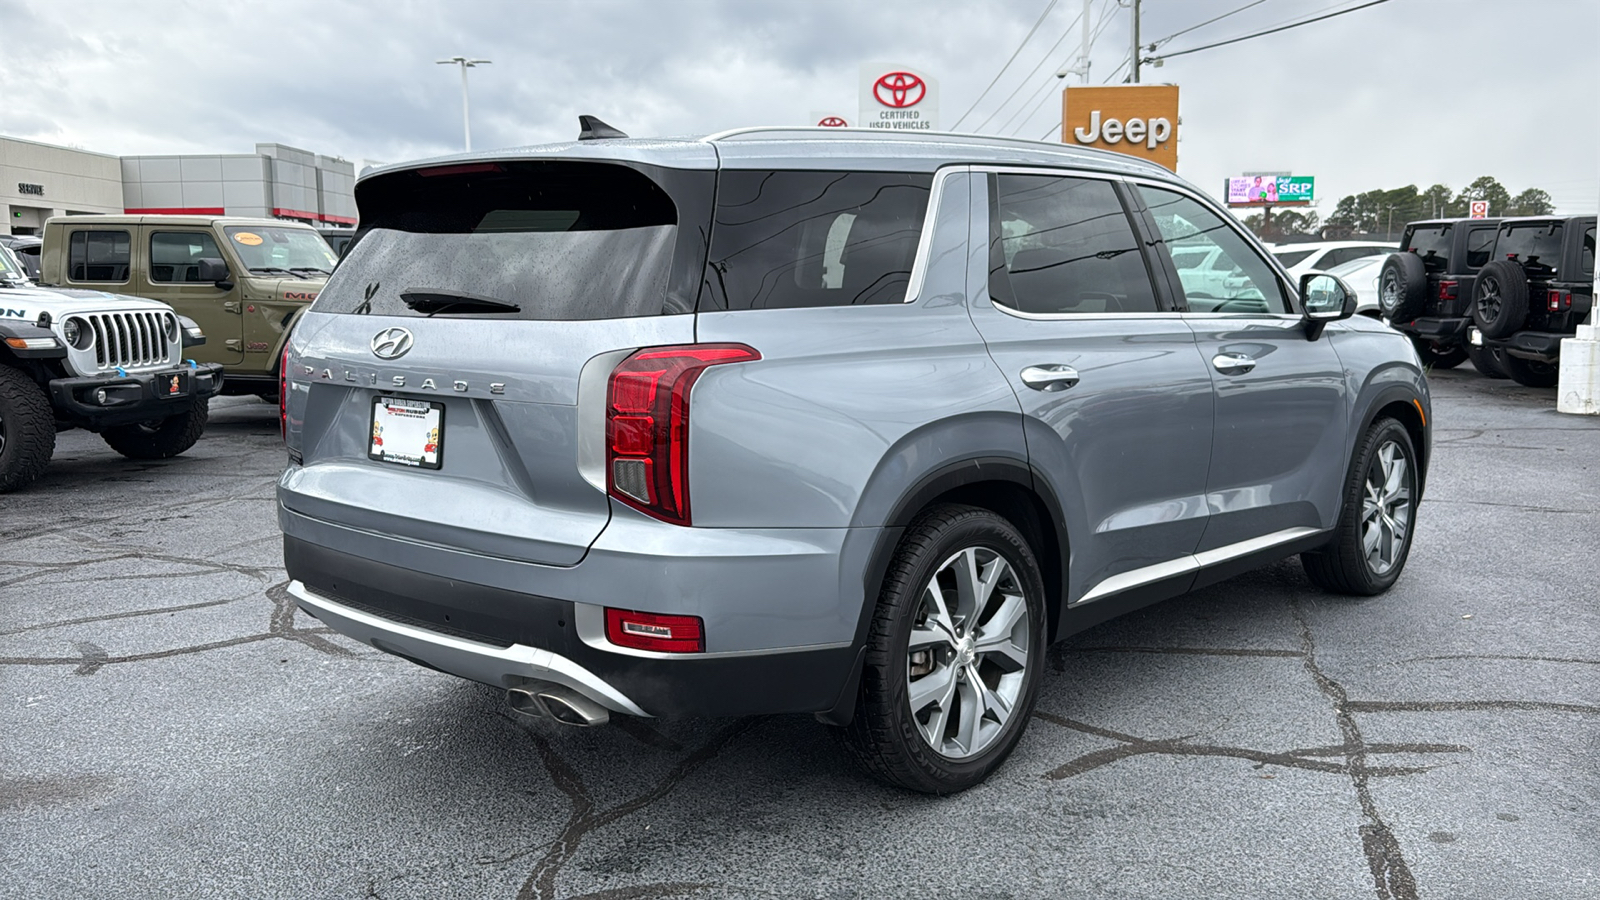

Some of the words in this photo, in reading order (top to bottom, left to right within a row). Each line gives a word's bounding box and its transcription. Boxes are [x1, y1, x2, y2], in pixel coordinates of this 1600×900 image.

[880, 111, 920, 120] CERTIFIED
[869, 121, 891, 129] USED
[892, 121, 930, 130] VEHICLES
[1074, 110, 1171, 149] Jeep
[18, 183, 45, 197] SERVICE
[1279, 183, 1312, 194] SRP
[0, 308, 26, 318] N
[304, 365, 506, 394] PALISADE
